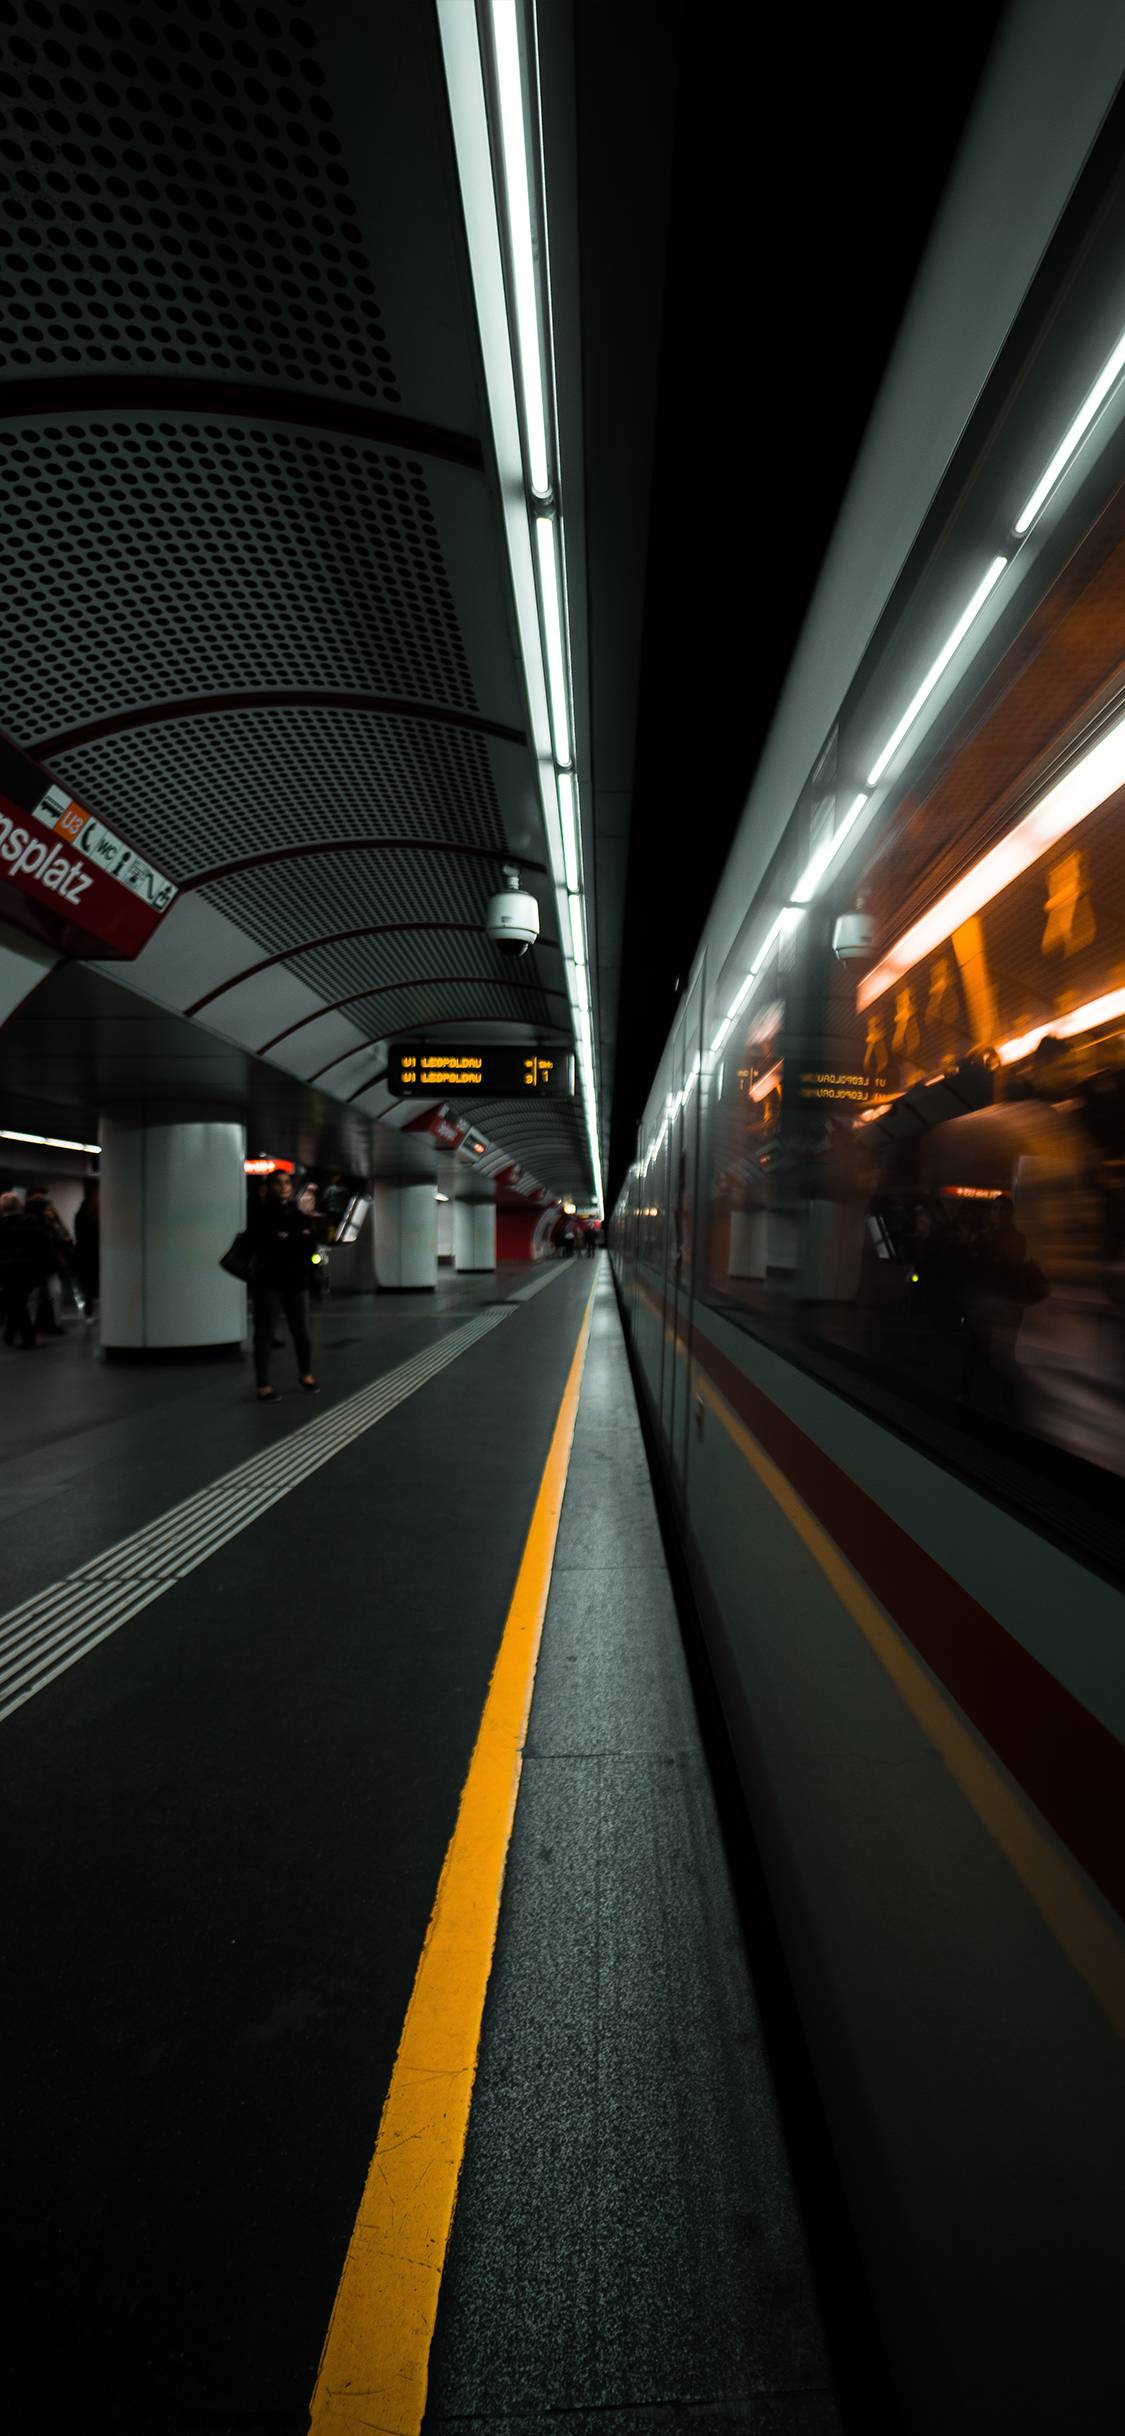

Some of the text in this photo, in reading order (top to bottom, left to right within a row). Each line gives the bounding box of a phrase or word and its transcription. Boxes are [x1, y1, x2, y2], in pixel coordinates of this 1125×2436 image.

[59, 811, 84, 834] U3
[97, 838, 117, 860] WC
[401, 1056, 483, 1069] U1 LEOPOLDAU
[401, 1072, 417, 1084] U1
[420, 1072, 483, 1084] LEOPOLDAU
